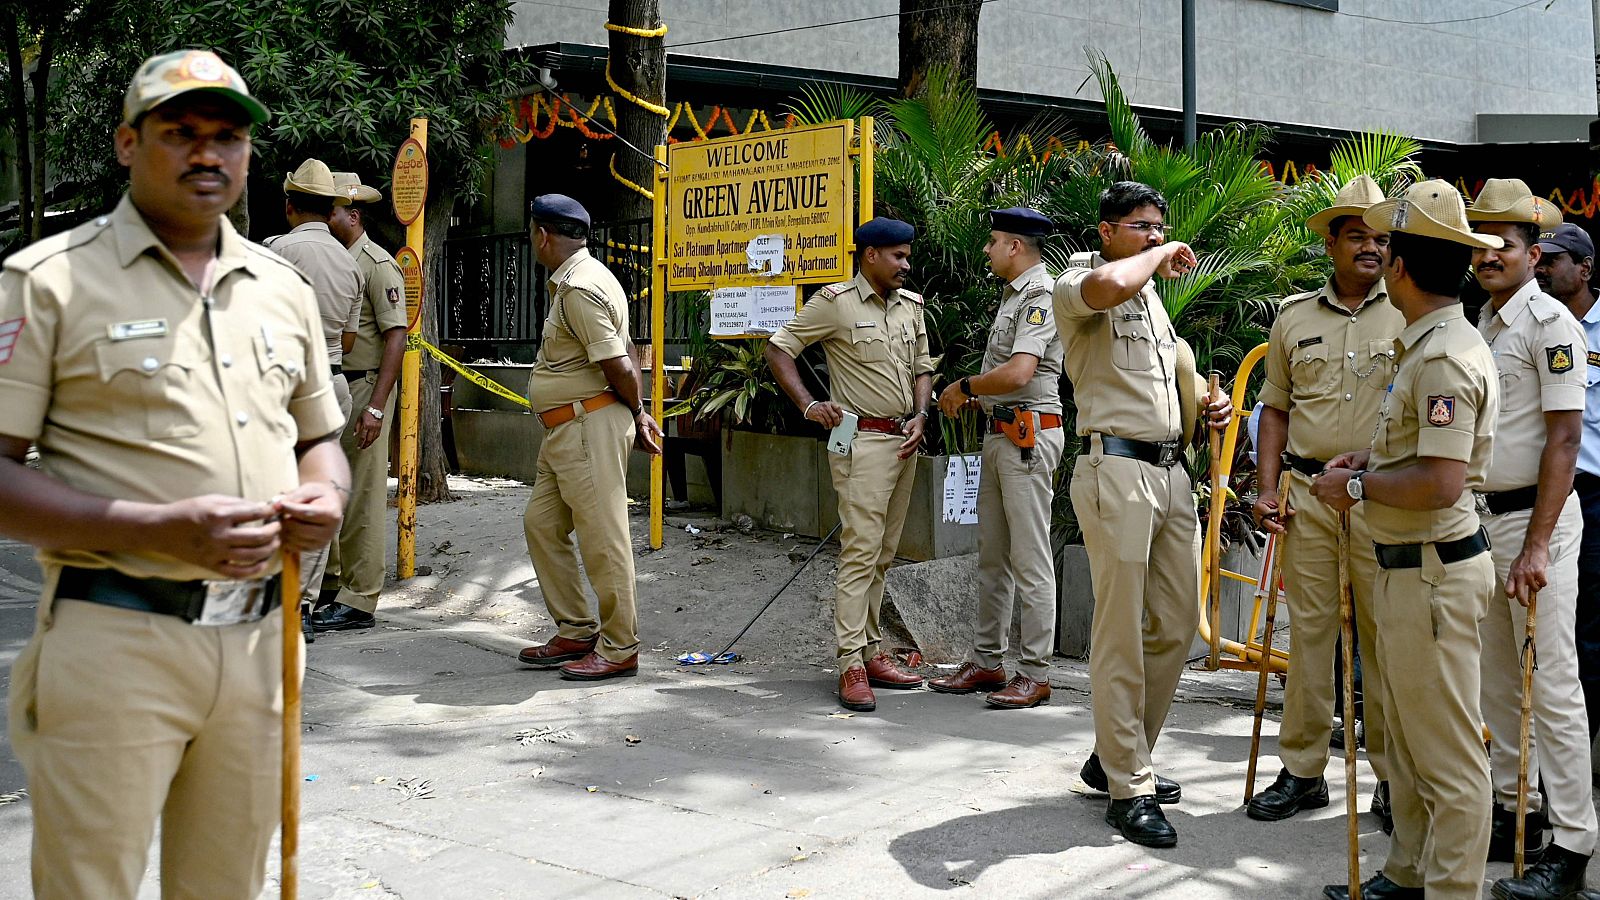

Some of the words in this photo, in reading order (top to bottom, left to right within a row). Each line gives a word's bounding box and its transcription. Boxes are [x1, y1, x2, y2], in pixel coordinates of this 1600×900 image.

[707, 138, 789, 168] WELCOME
[722, 165, 765, 178] MAHANAGARA
[828, 155, 841, 166] ZONE
[683, 182, 741, 219] GREEN
[745, 173, 829, 214] AVENUE
[762, 216, 775, 229] Main
[673, 242, 684, 258] Sai
[686, 240, 715, 257] Platinum
[796, 232, 838, 254] Apartment
[402, 266, 418, 276] NING
[672, 262, 697, 282] Sterling
[698, 260, 722, 277] Shalom
[782, 254, 796, 276] Sky
[797, 254, 838, 276] Apartment
[723, 291, 736, 299] SHREE
